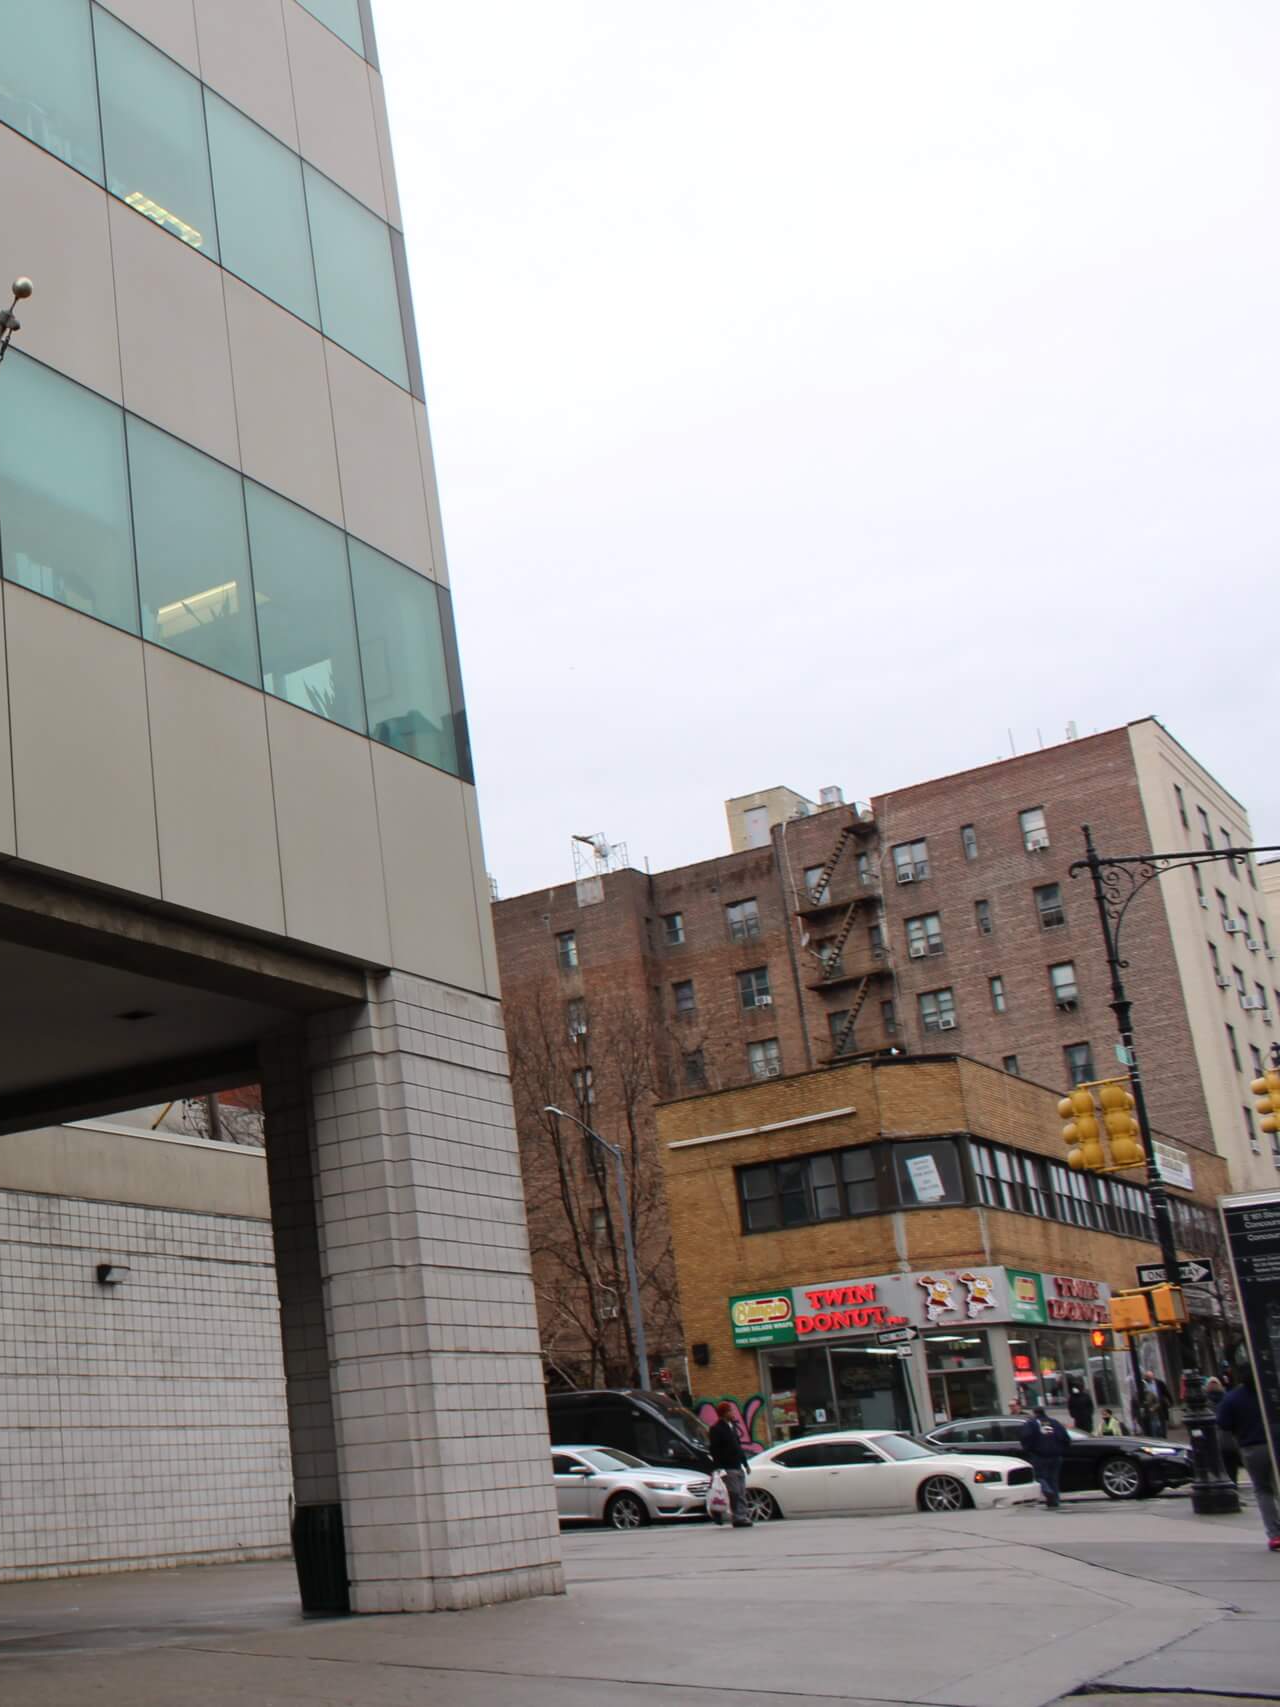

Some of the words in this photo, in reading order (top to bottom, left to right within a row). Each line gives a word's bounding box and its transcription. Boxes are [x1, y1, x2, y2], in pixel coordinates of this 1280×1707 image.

[806, 1284, 876, 1309] TWIN
[1054, 1277, 1099, 1300] TWIN
[795, 1306, 888, 1334] DONUT
